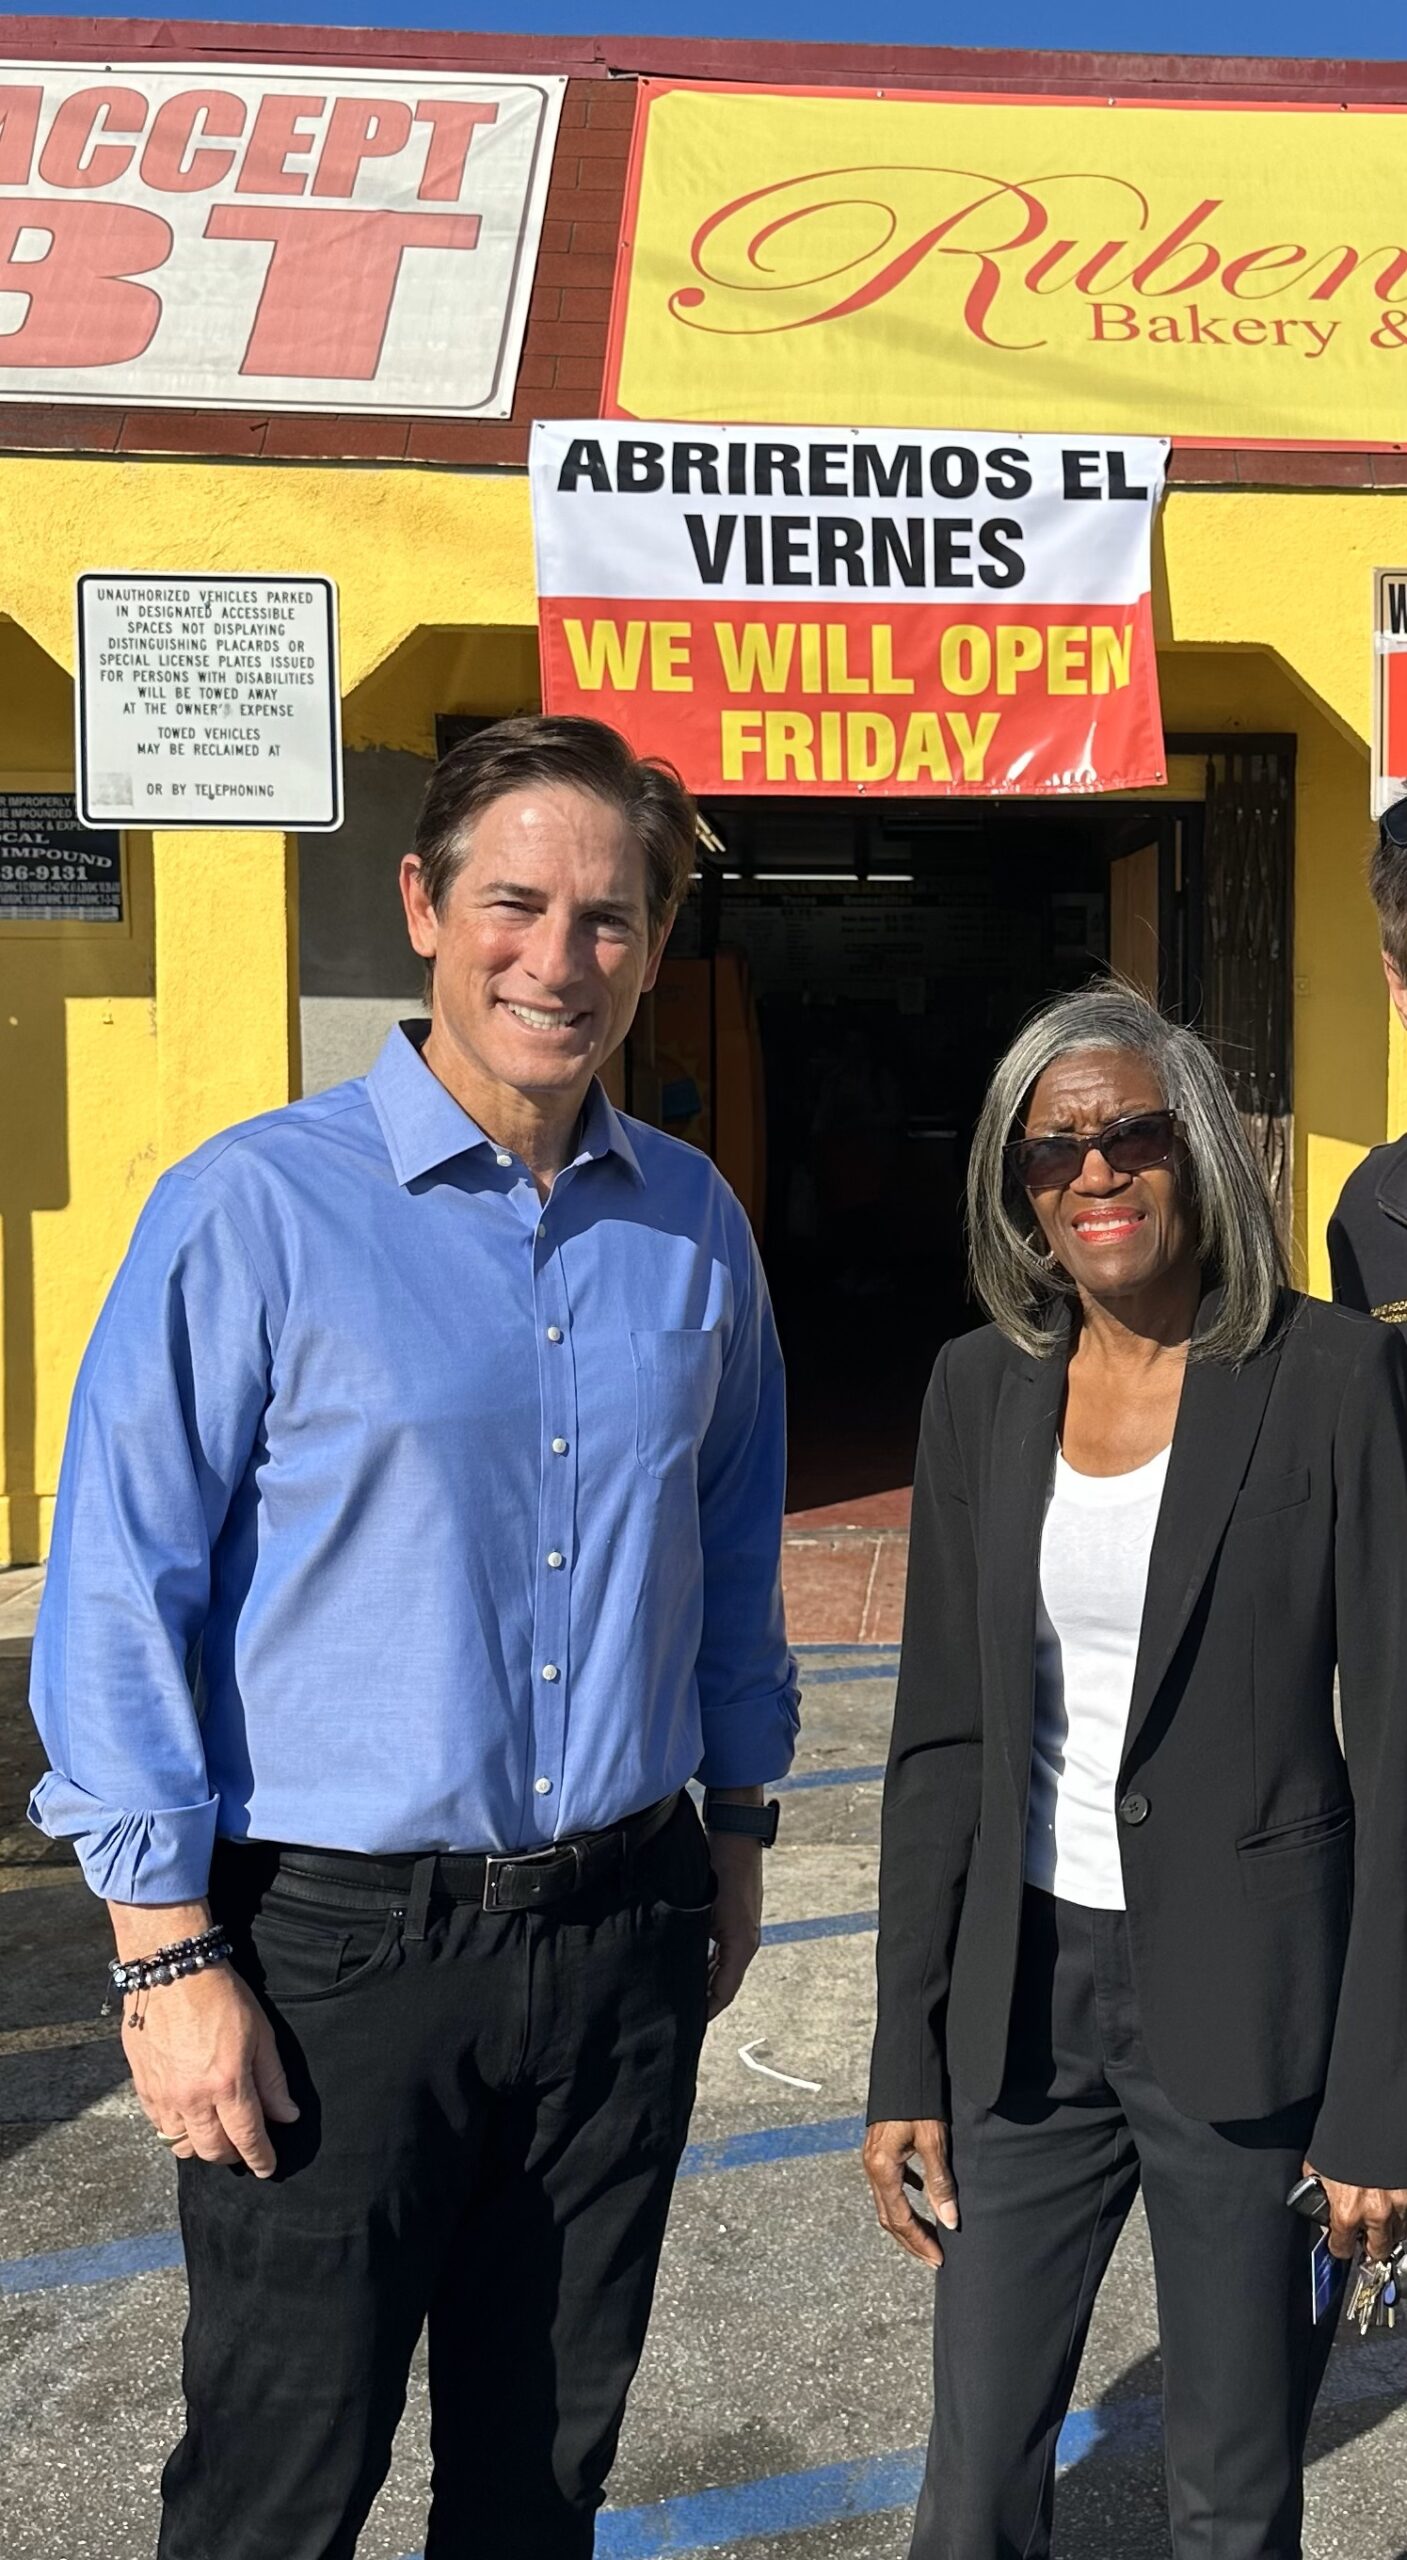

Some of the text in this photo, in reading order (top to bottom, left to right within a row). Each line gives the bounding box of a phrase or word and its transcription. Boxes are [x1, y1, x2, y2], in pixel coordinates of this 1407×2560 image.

[1087, 302, 1407, 358] Bakery &
[557, 439, 1148, 502] ABRIREMOS EL
[685, 513, 1026, 589] VIERNES
[97, 589, 313, 604] UNAUTHORIZED VEHICLES PARKED
[116, 606, 295, 620] IN DESIGNATED ACCESSIBLE
[128, 622, 285, 635] SPACES NOT DISPLAYING
[109, 638, 304, 652] DISTINGUISHING PLACARDS OR
[100, 654, 315, 669] SPECIAL LICENSE PLATES ISSUED
[563, 618, 1133, 696] WE WILL OPEN
[100, 671, 314, 685] FOR PERSONS WITH DISABILITIES
[138, 687, 277, 701] WILL BE TOWED AWAY
[123, 703, 135, 714] AT
[145, 703, 166, 715] THE
[240, 705, 294, 717] EXPENSE
[158, 727, 260, 740] TOWED VEHICLES
[137, 744, 280, 756] MAY BE RECLAIMED AT
[721, 710, 1001, 783] FRIDAY
[147, 784, 274, 797] OR BY TELEPHONING
[8, 796, 71, 807] IMPROPERLY
[11, 808, 72, 819] IMPOUNDED
[0, 832, 50, 844] CAL
[1, 847, 113, 869] IMPOUND
